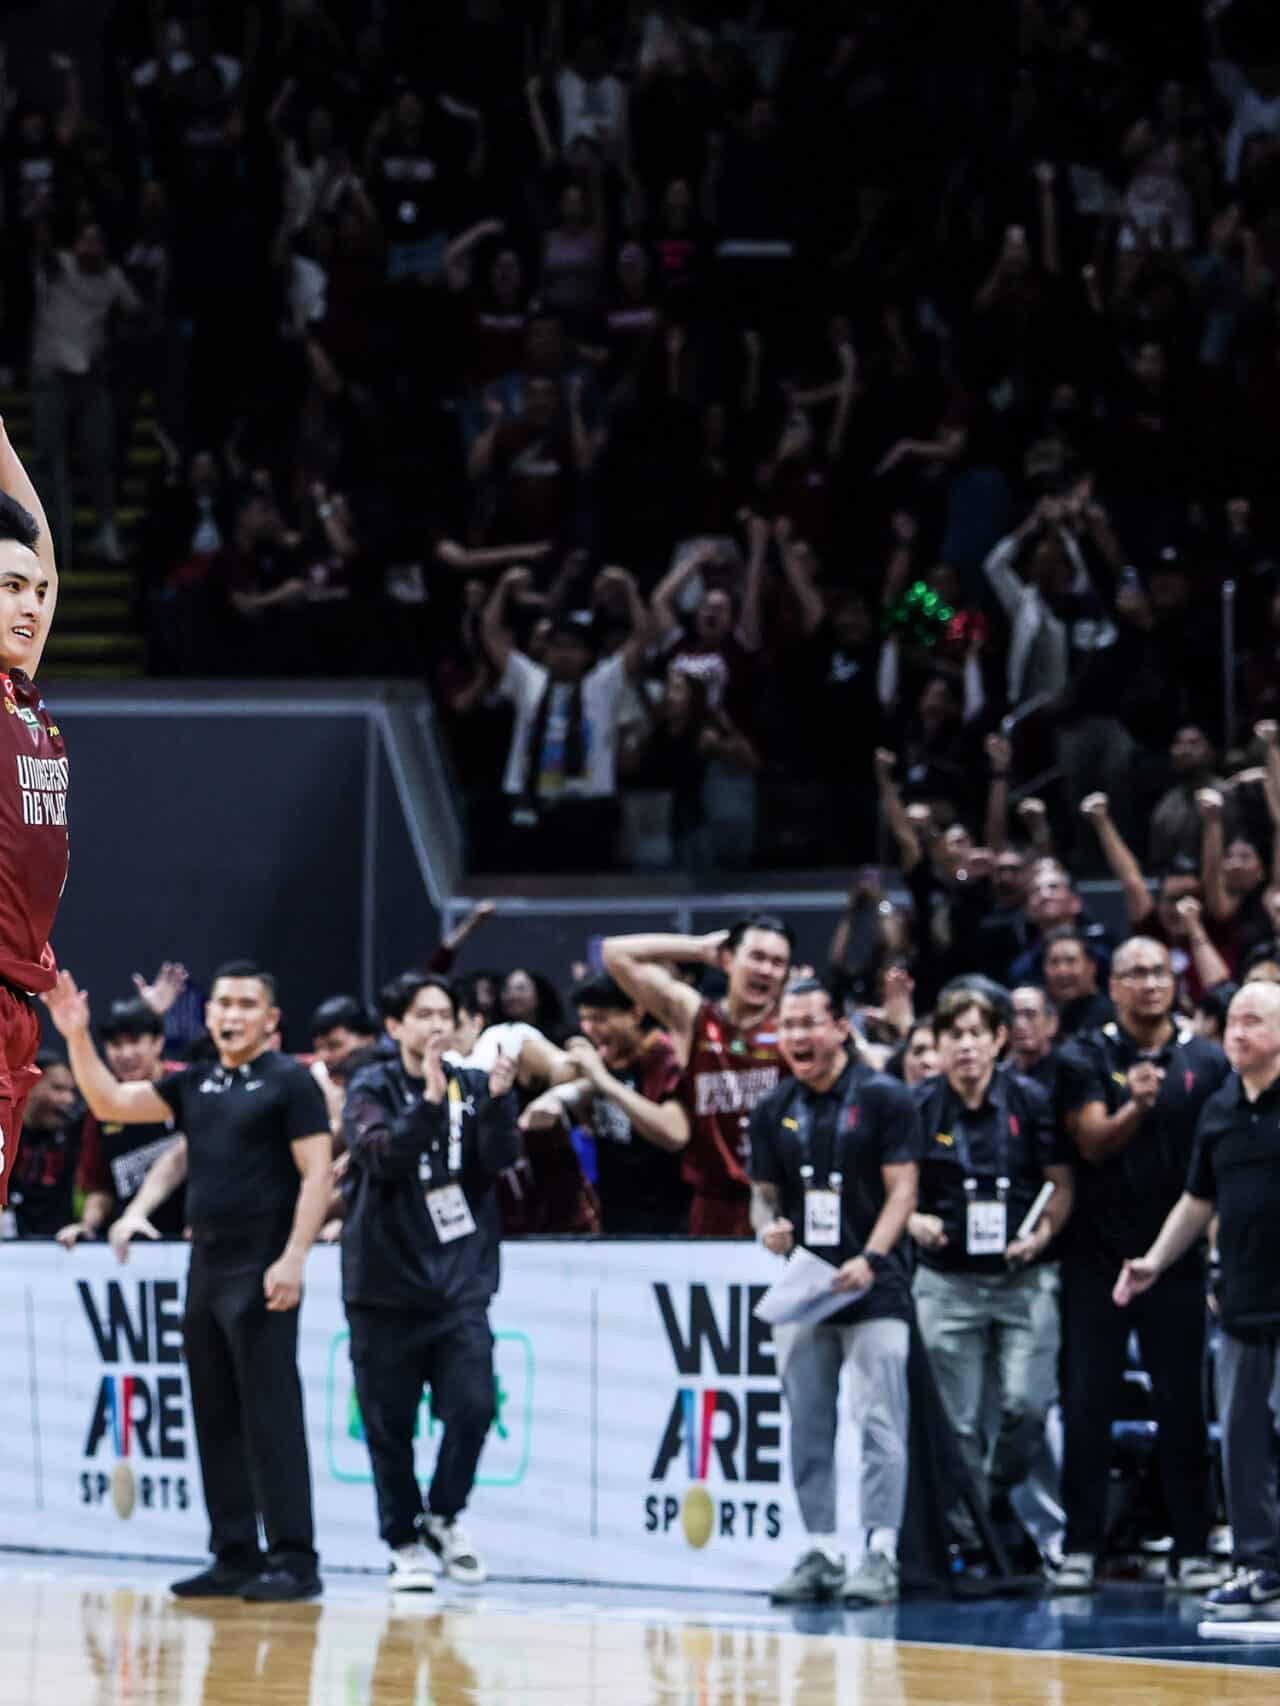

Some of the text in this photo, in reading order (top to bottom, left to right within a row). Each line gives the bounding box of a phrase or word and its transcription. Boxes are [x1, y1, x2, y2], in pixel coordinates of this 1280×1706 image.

[76, 1280, 184, 1364] WE
[652, 1282, 777, 1376] WE
[84, 1375, 187, 1459] ARE
[651, 1388, 781, 1482] ARE
